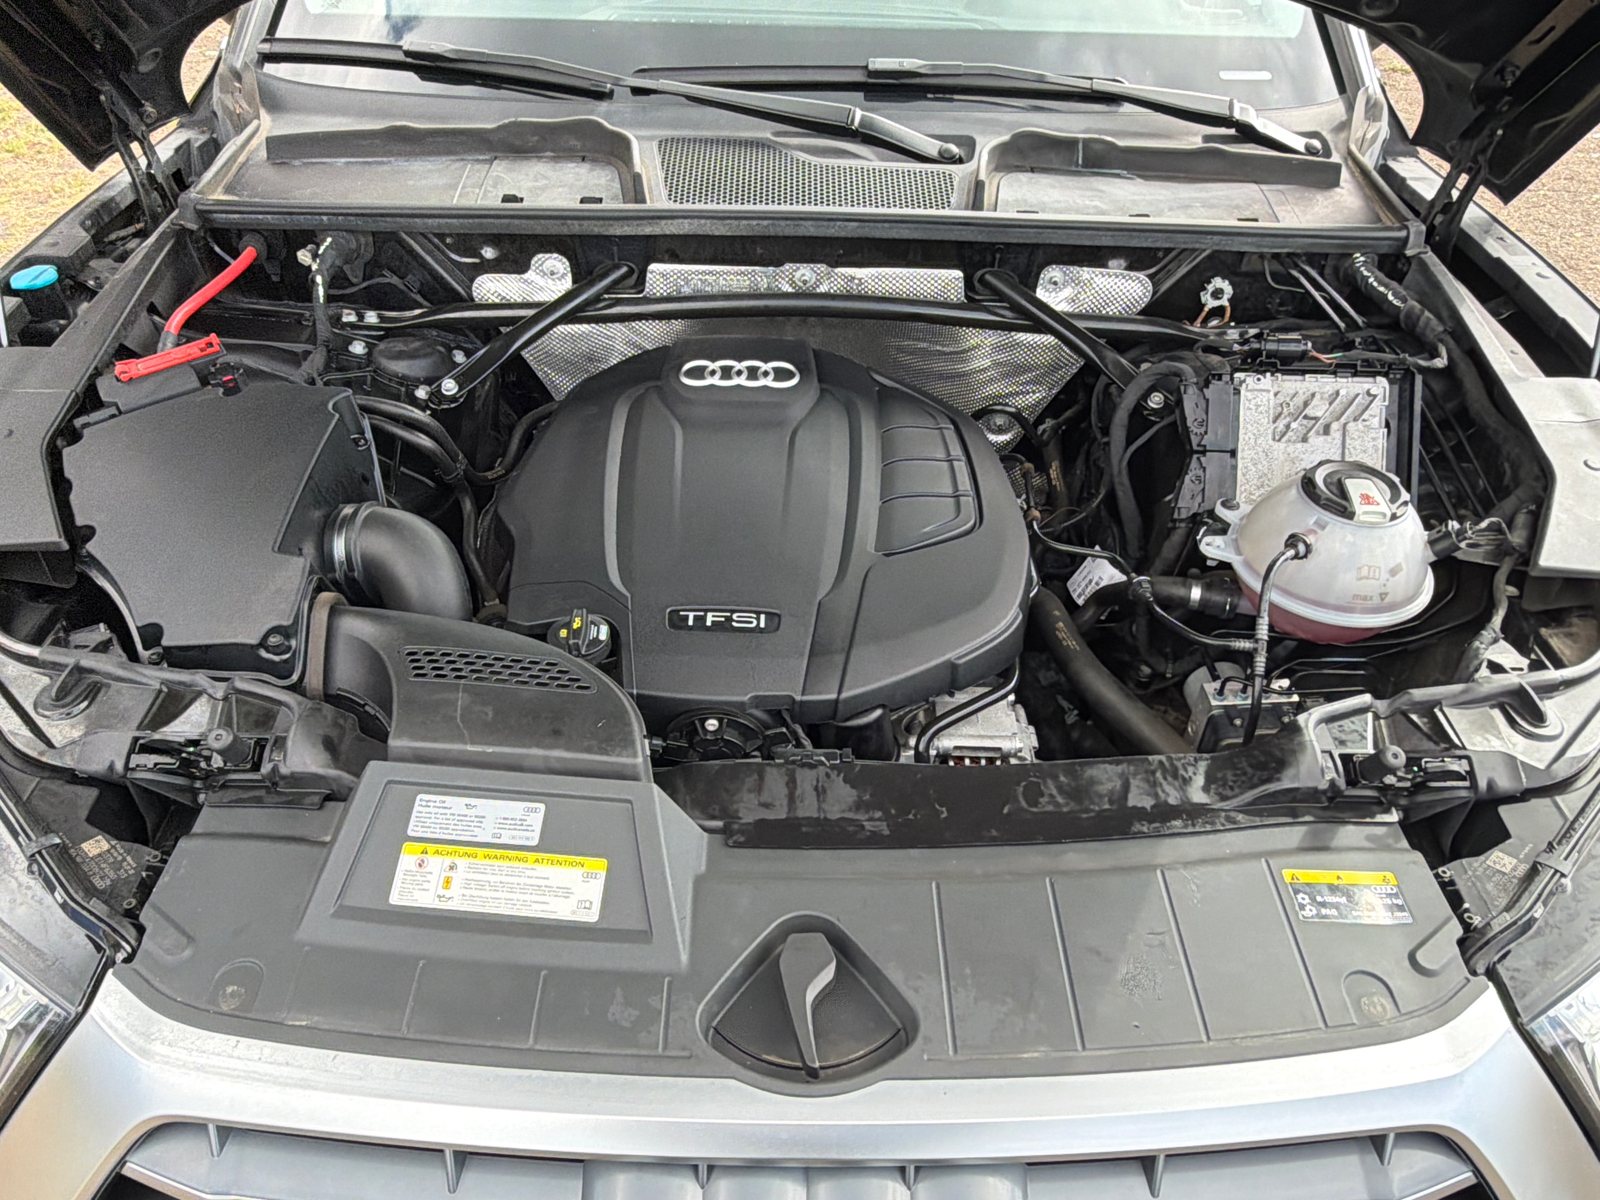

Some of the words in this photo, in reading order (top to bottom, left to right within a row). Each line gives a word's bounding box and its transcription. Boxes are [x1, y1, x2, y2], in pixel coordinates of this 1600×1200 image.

[1351, 593, 1374, 602] max
[679, 611, 766, 628] TFSI
[432, 849, 478, 859] ACHTUNG
[483, 853, 529, 863] WARNING
[533, 857, 586, 868] ATTENTION
